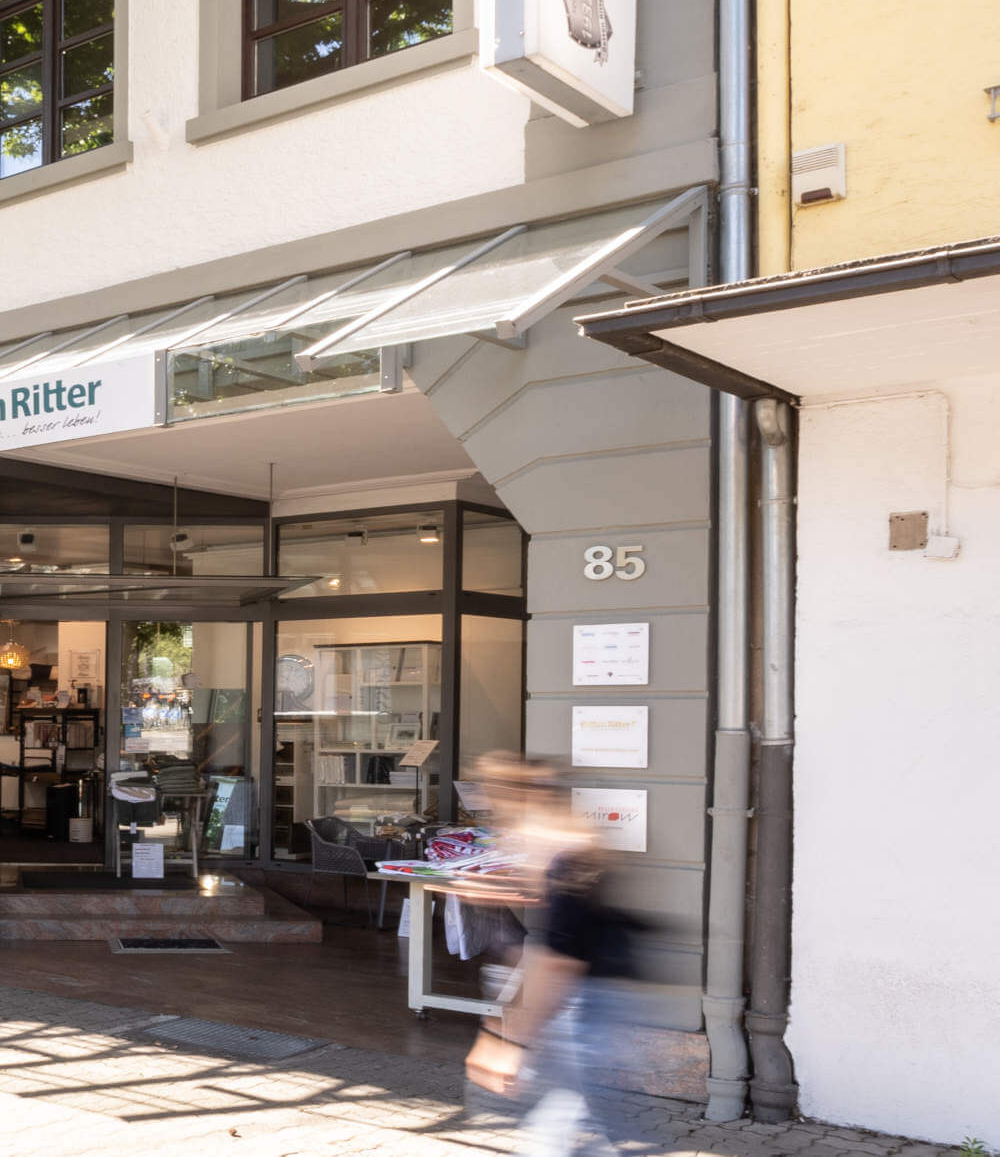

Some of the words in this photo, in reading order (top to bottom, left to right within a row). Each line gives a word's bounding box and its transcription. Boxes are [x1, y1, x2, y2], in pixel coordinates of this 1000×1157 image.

[11, 379, 103, 420] Ritter
[22, 421, 58, 436] besser
[583, 545, 646, 581] 85
